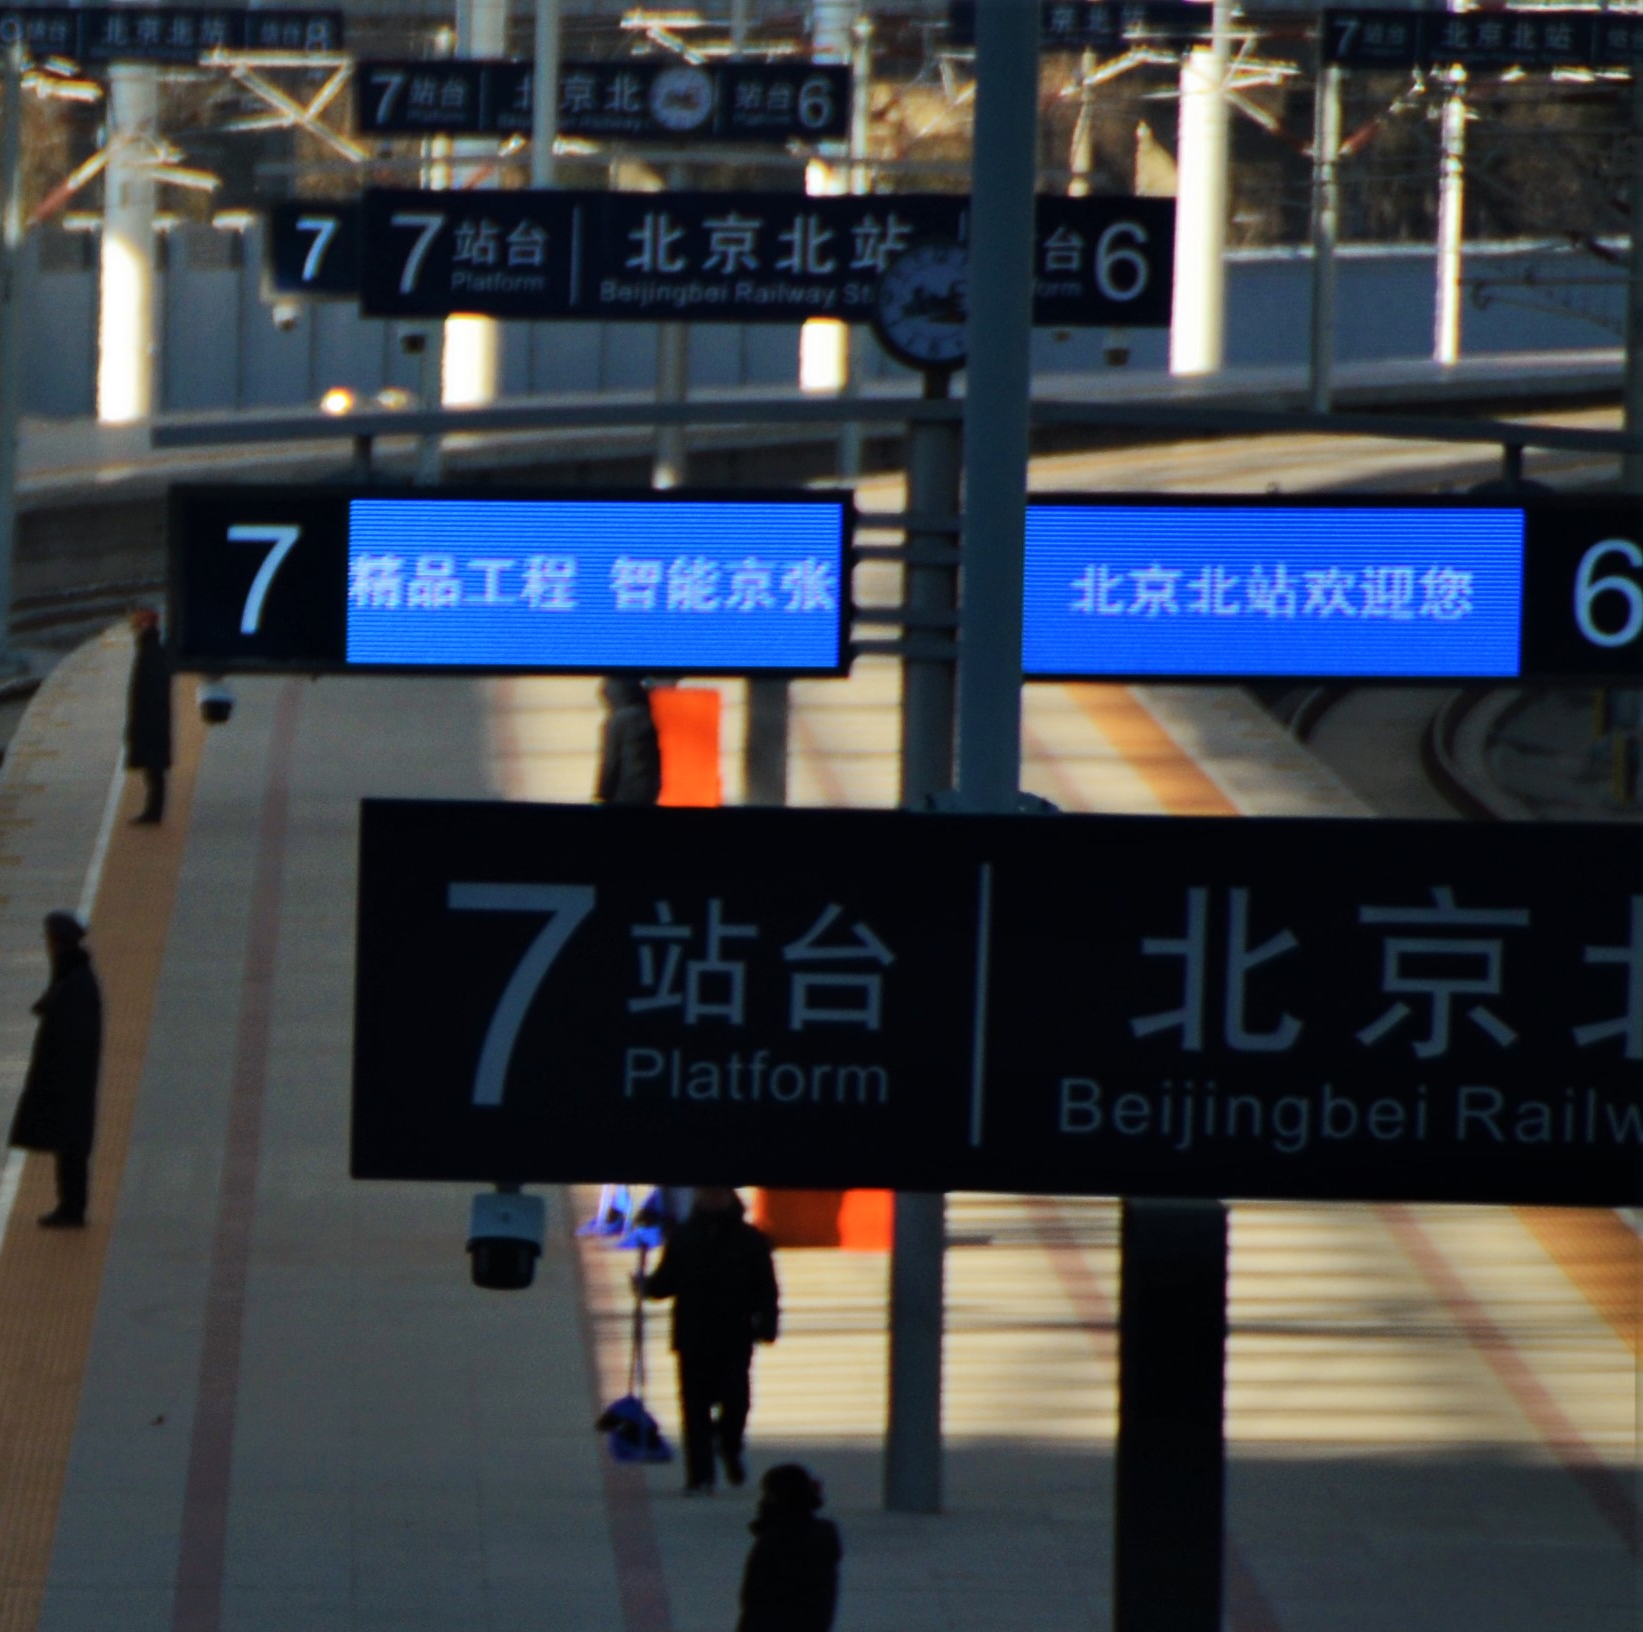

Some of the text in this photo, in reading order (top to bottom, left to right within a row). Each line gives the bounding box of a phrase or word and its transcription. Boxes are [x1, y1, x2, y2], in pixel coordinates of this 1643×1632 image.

[1334, 17, 1361, 56] 7
[369, 71, 405, 125] 7
[798, 75, 837, 129] 6
[294, 214, 342, 283] 7
[388, 210, 550, 296] 7 站台
[624, 210, 915, 276] 北京北站
[1042, 220, 1151, 303] 台 6
[450, 270, 547, 294] Platform
[600, 280, 728, 308] Beijingbei
[734, 282, 836, 309] Railway
[226, 522, 305, 636] 7
[348, 551, 840, 614] 精品工程 智能京张
[1068, 560, 1475, 621] 北京北站欢迎您
[1572, 537, 1643, 649] 6
[445, 880, 898, 1108] 7 站台
[622, 1045, 891, 1106] Platform
[1057, 1074, 1431, 1156] Beijingbei
